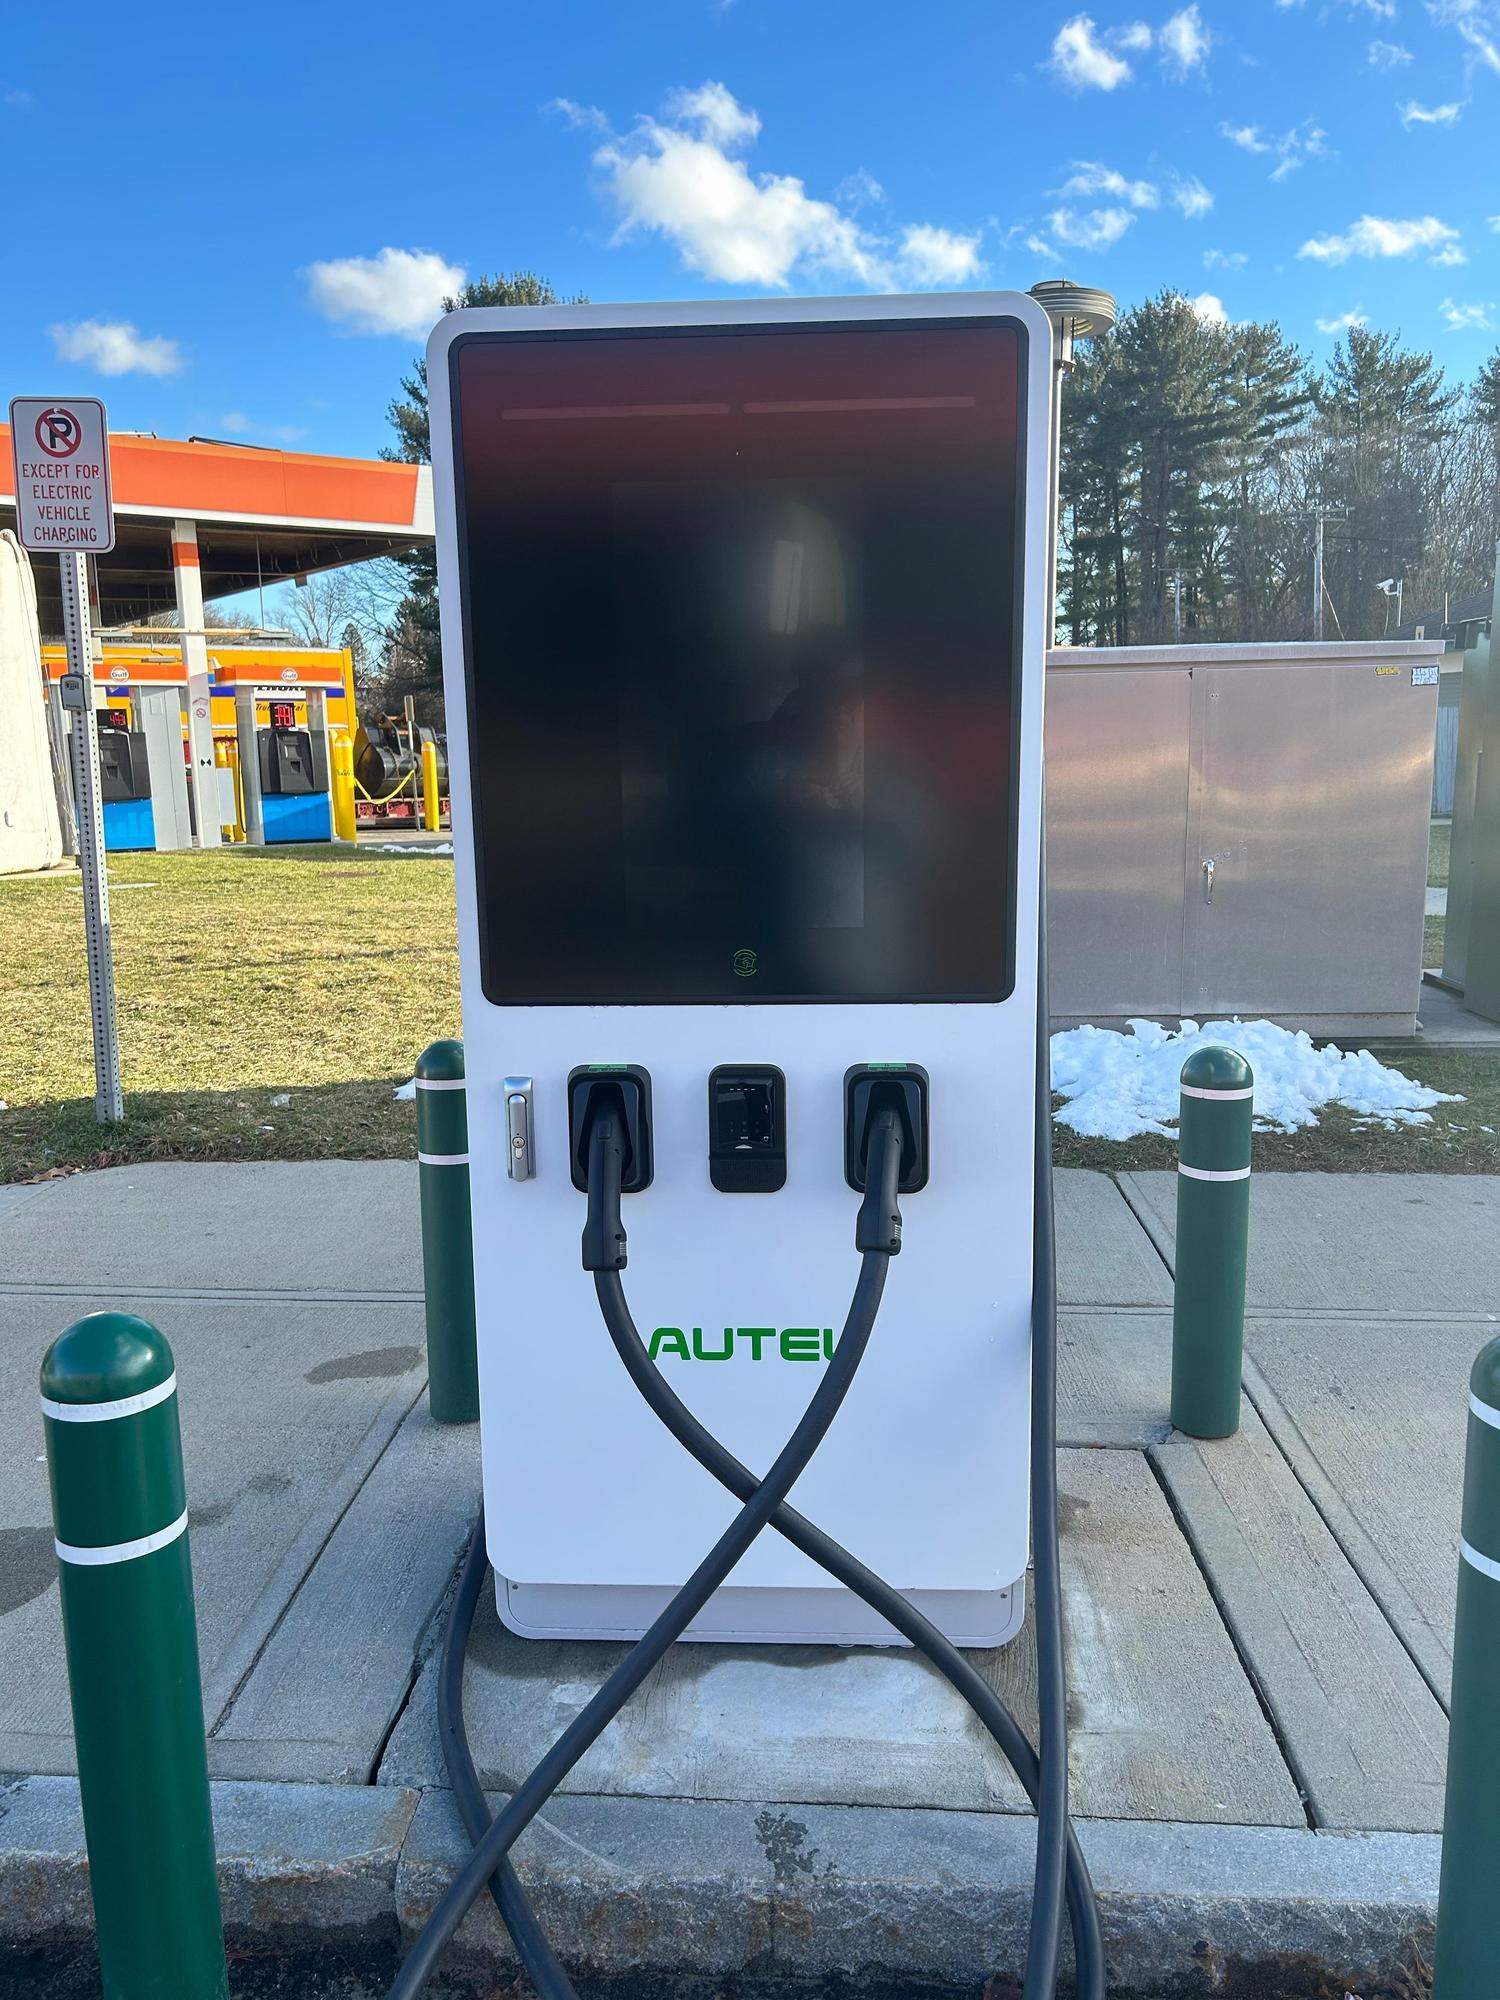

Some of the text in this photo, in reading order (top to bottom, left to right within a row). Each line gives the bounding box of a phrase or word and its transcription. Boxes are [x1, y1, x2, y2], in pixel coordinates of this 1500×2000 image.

[22, 463, 100, 480] EXCEPT FOR
[33, 485, 92, 500] ELECTRIC
[37, 505, 91, 521] VEHICLE
[34, 526, 97, 542] CHARGING
